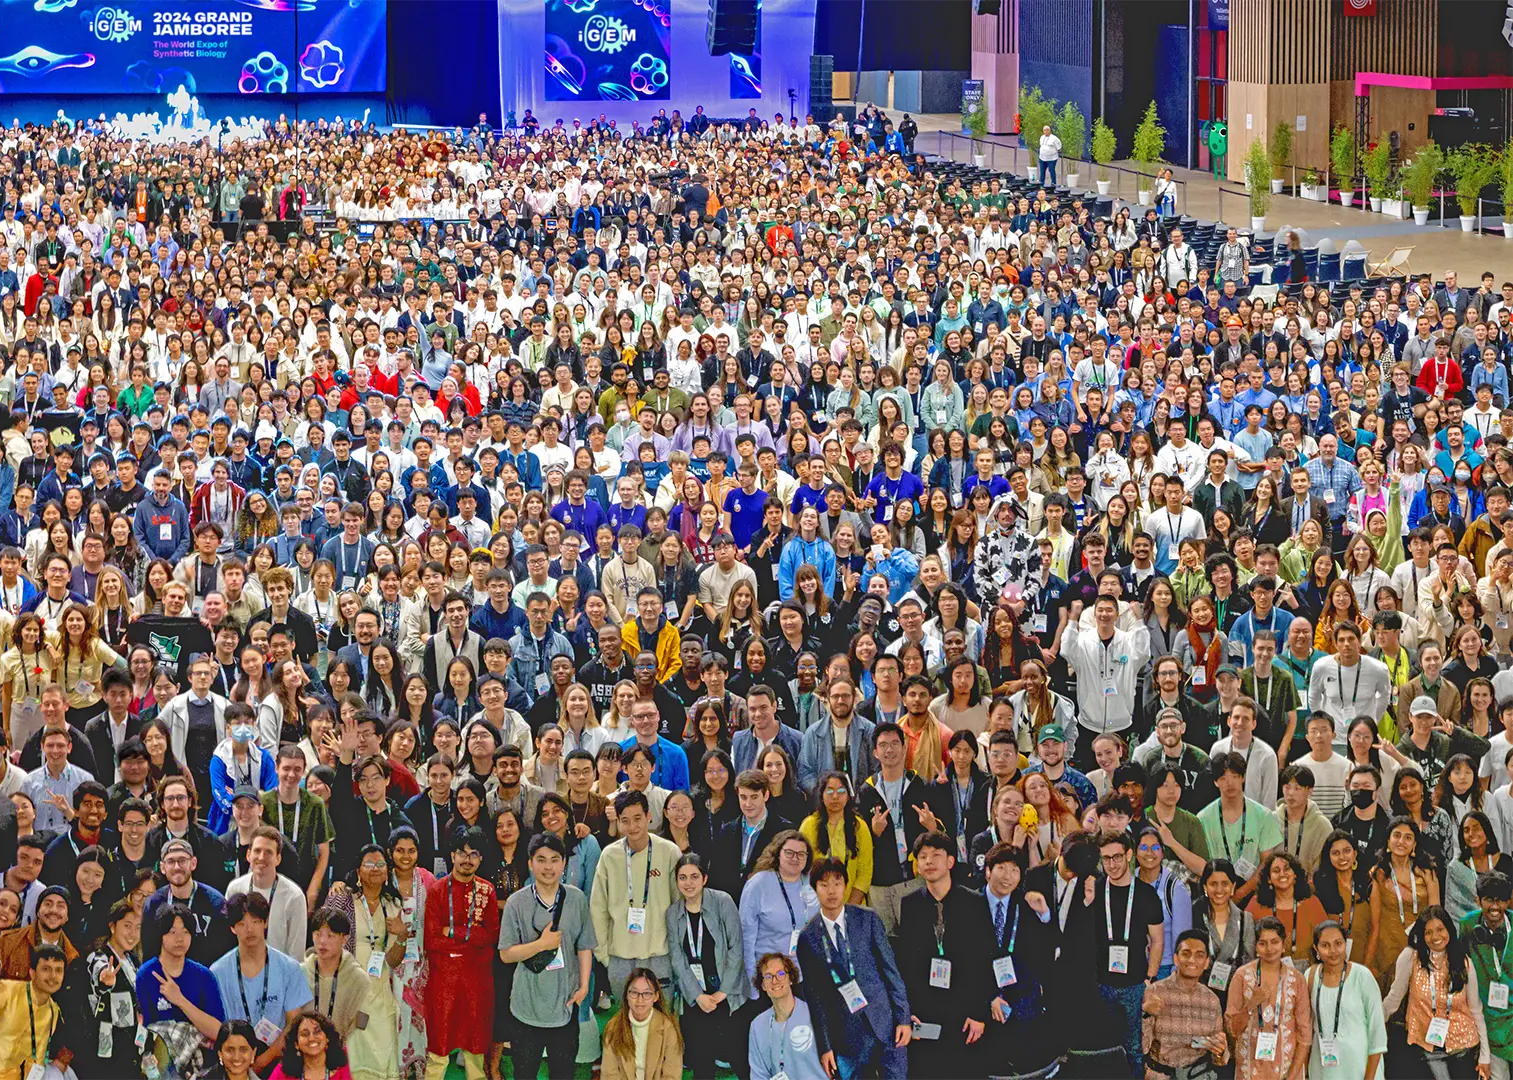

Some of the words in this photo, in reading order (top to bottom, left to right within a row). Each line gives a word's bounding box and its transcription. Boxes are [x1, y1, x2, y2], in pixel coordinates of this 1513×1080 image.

[153, 12, 192, 23] 2024
[194, 12, 253, 23] GRAND
[153, 24, 253, 36] JAMBOREE
[153, 41, 170, 49] The
[170, 41, 195, 49] World
[196, 41, 218, 50] Expo
[218, 41, 228, 49] of
[153, 50, 195, 59] Synthetic
[196, 50, 227, 59] Biology
